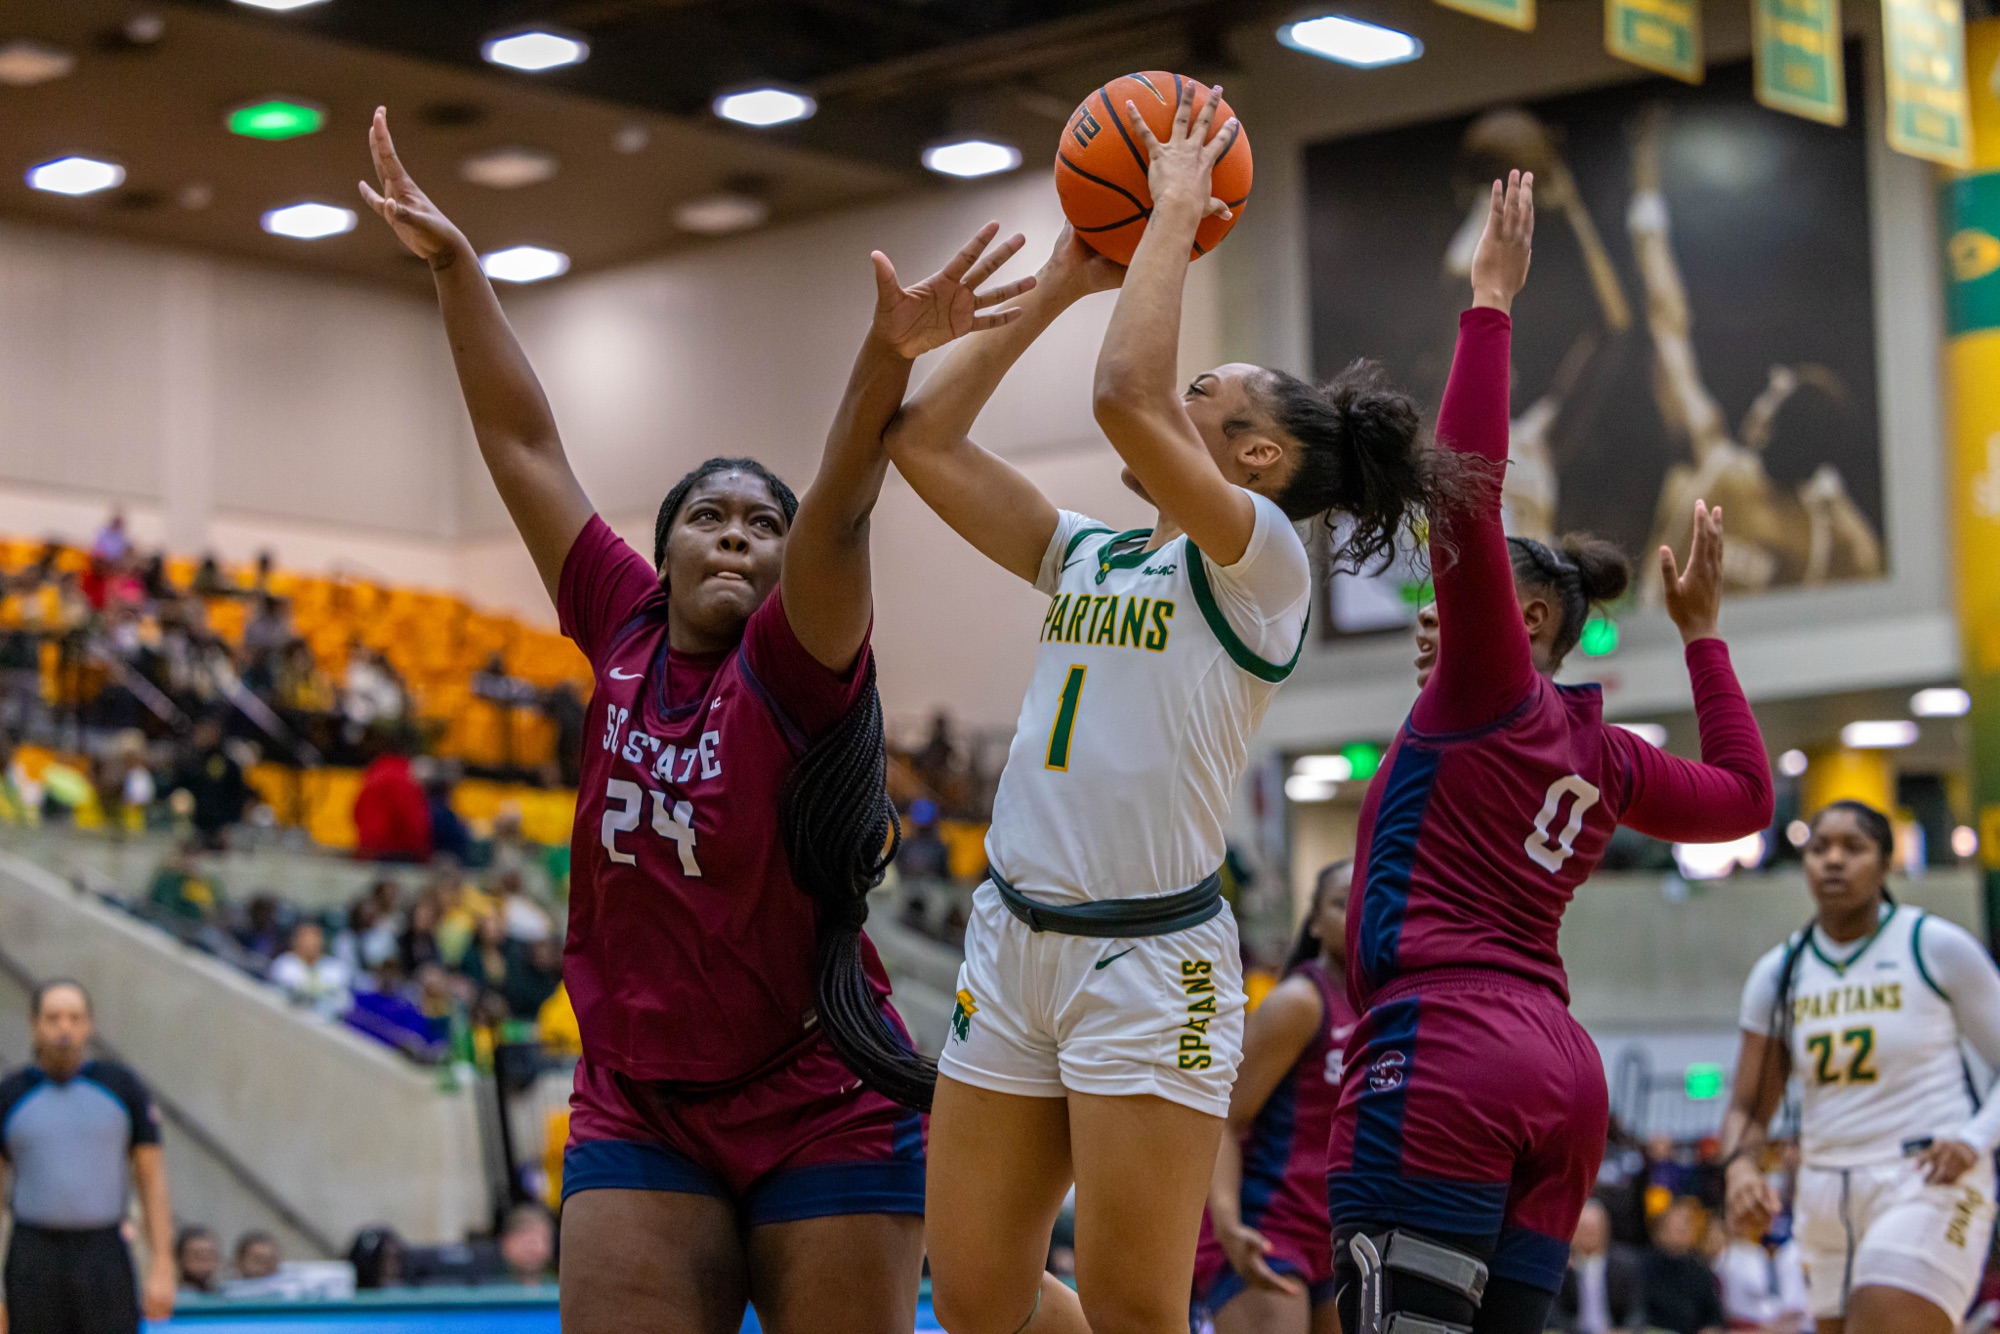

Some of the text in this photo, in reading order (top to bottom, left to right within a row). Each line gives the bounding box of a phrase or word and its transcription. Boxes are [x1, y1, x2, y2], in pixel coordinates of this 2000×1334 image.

[603, 703, 629, 755] SC
[1044, 664, 1088, 772] 1
[601, 777, 702, 877] 24
[1524, 774, 1600, 874] 0
[1790, 983, 1902, 1026] PARTANS
[1806, 1027, 1878, 1086] 22
